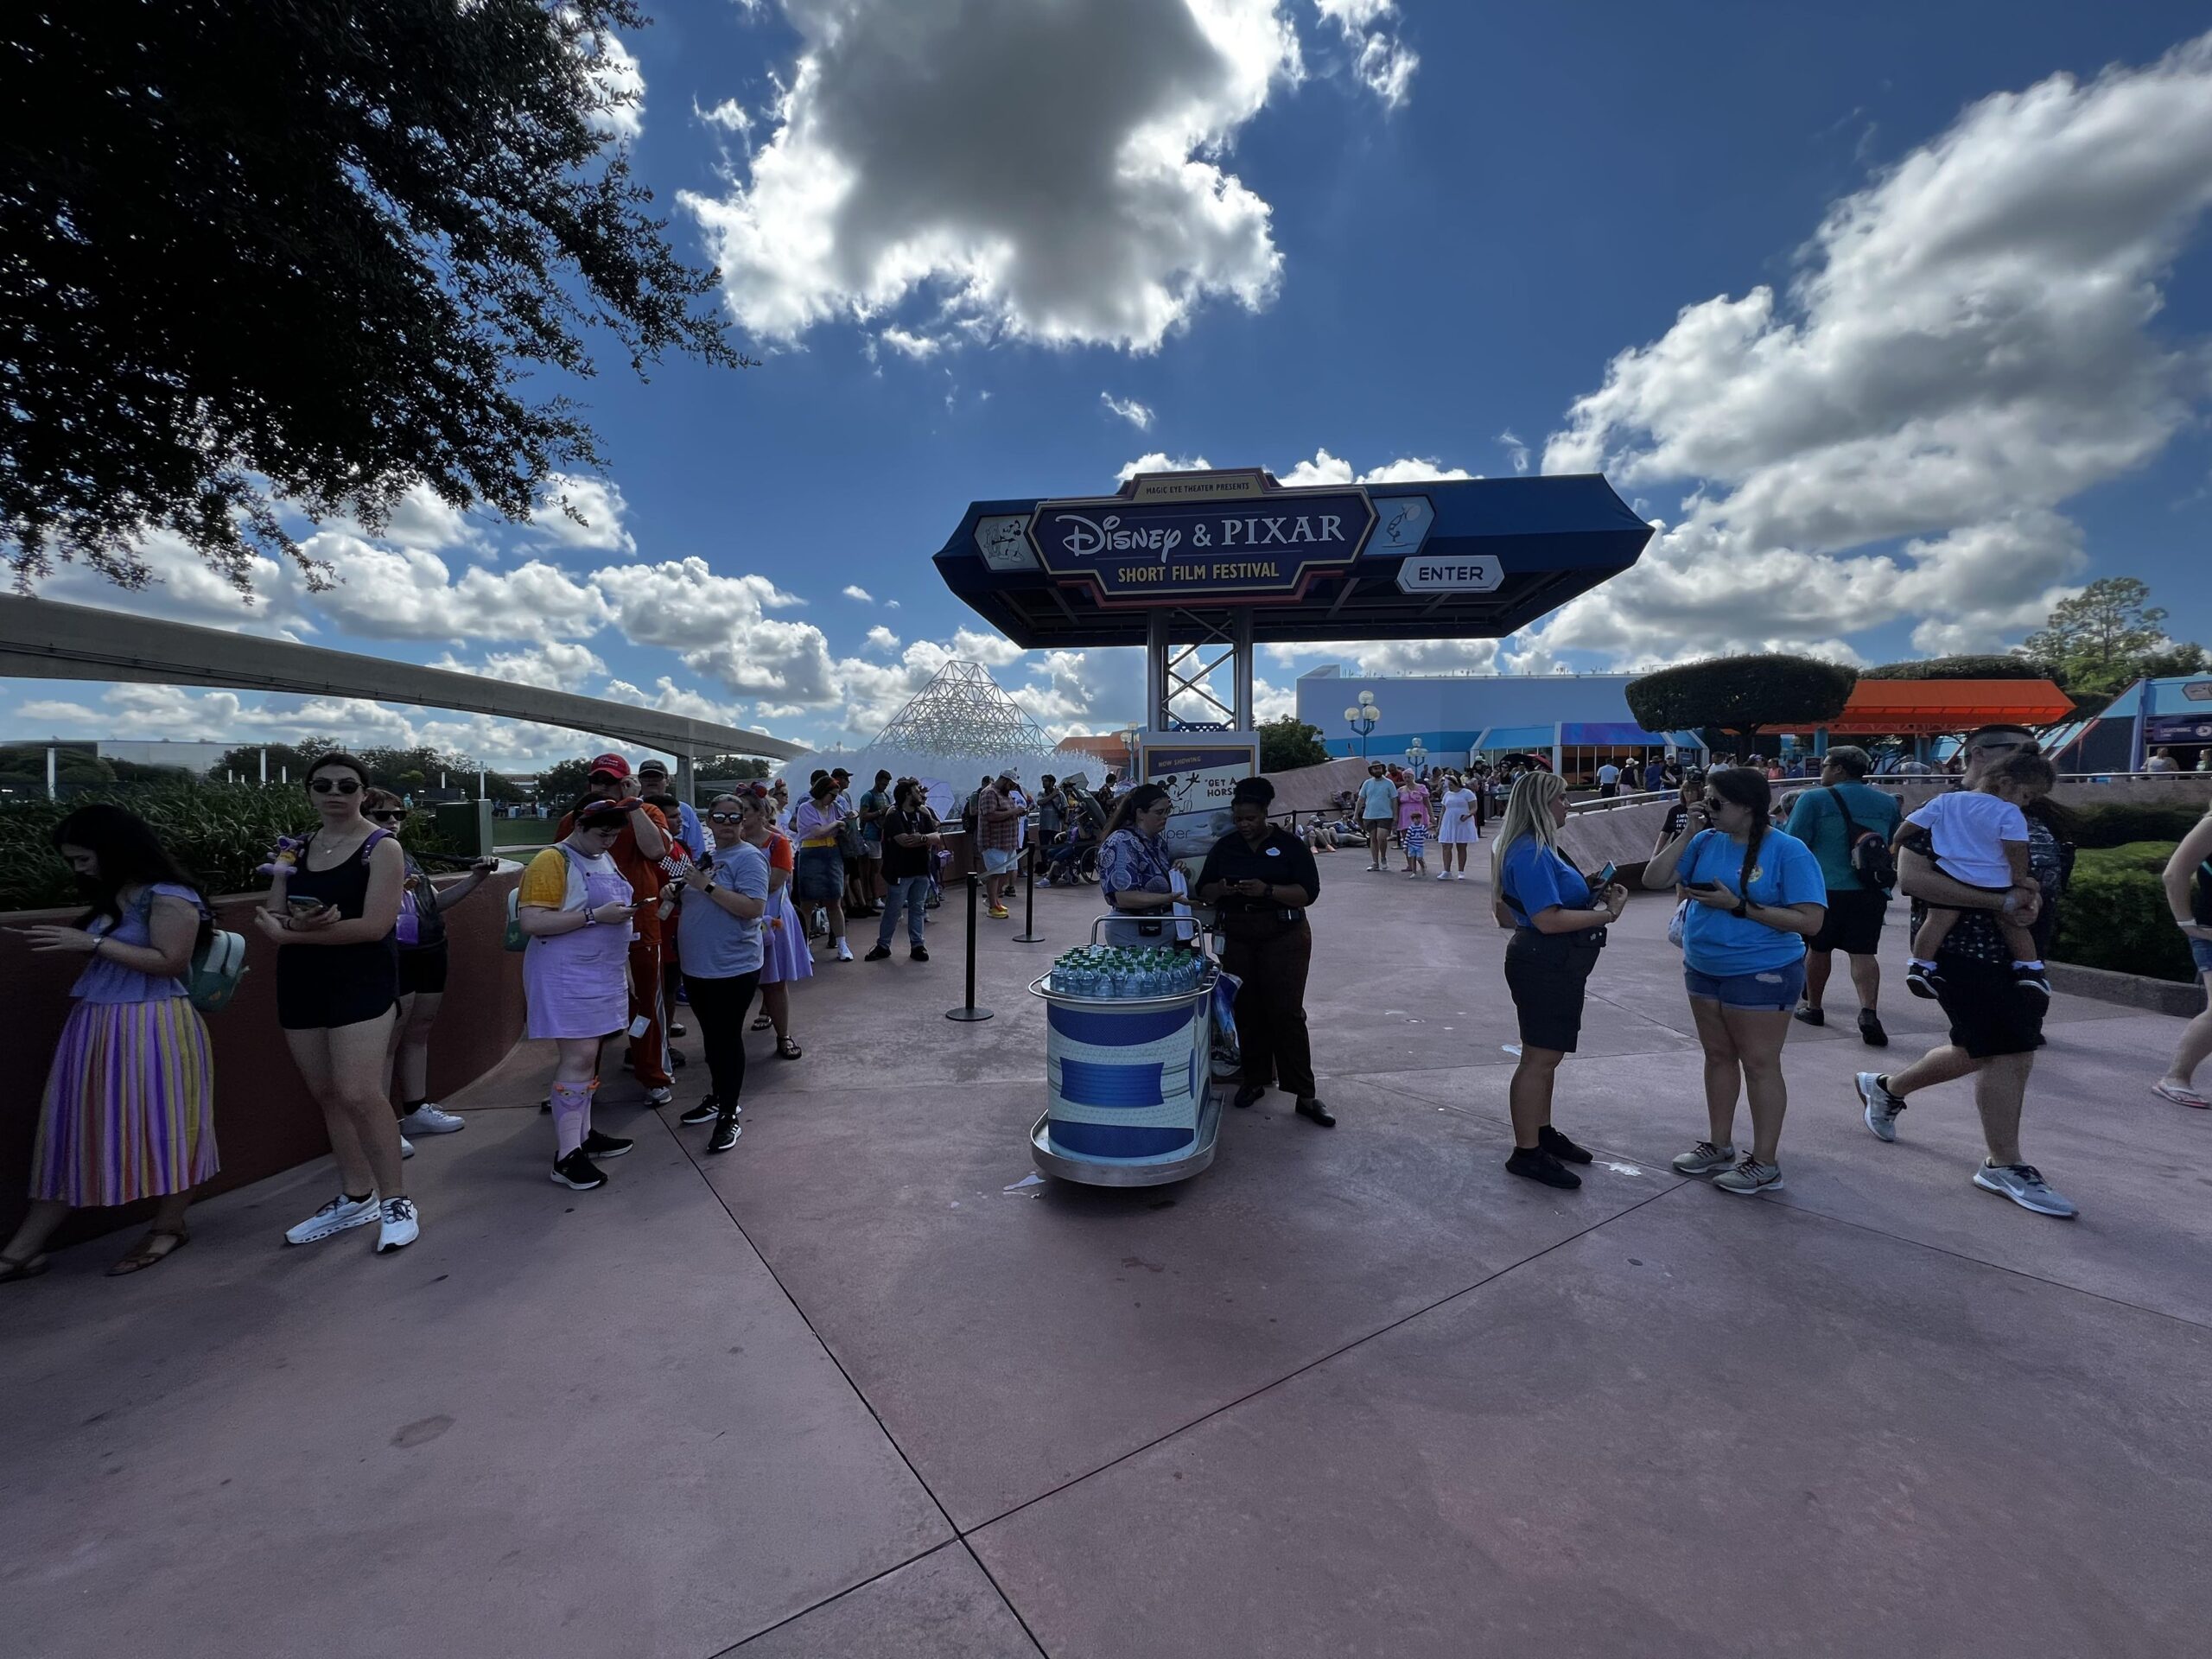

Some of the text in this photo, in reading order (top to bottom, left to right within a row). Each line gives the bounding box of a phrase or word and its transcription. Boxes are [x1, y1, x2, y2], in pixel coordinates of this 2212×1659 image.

[1146, 482, 1249, 494] MAGIC EYE THEATER PRESENTS
[1192, 524, 1212, 547] &
[1221, 515, 1345, 546] PIXAR
[1118, 562, 1280, 583] SHORT FILM FESTIVAL
[1419, 566, 1484, 582] ENTER
[1230, 776, 1237, 785] A
